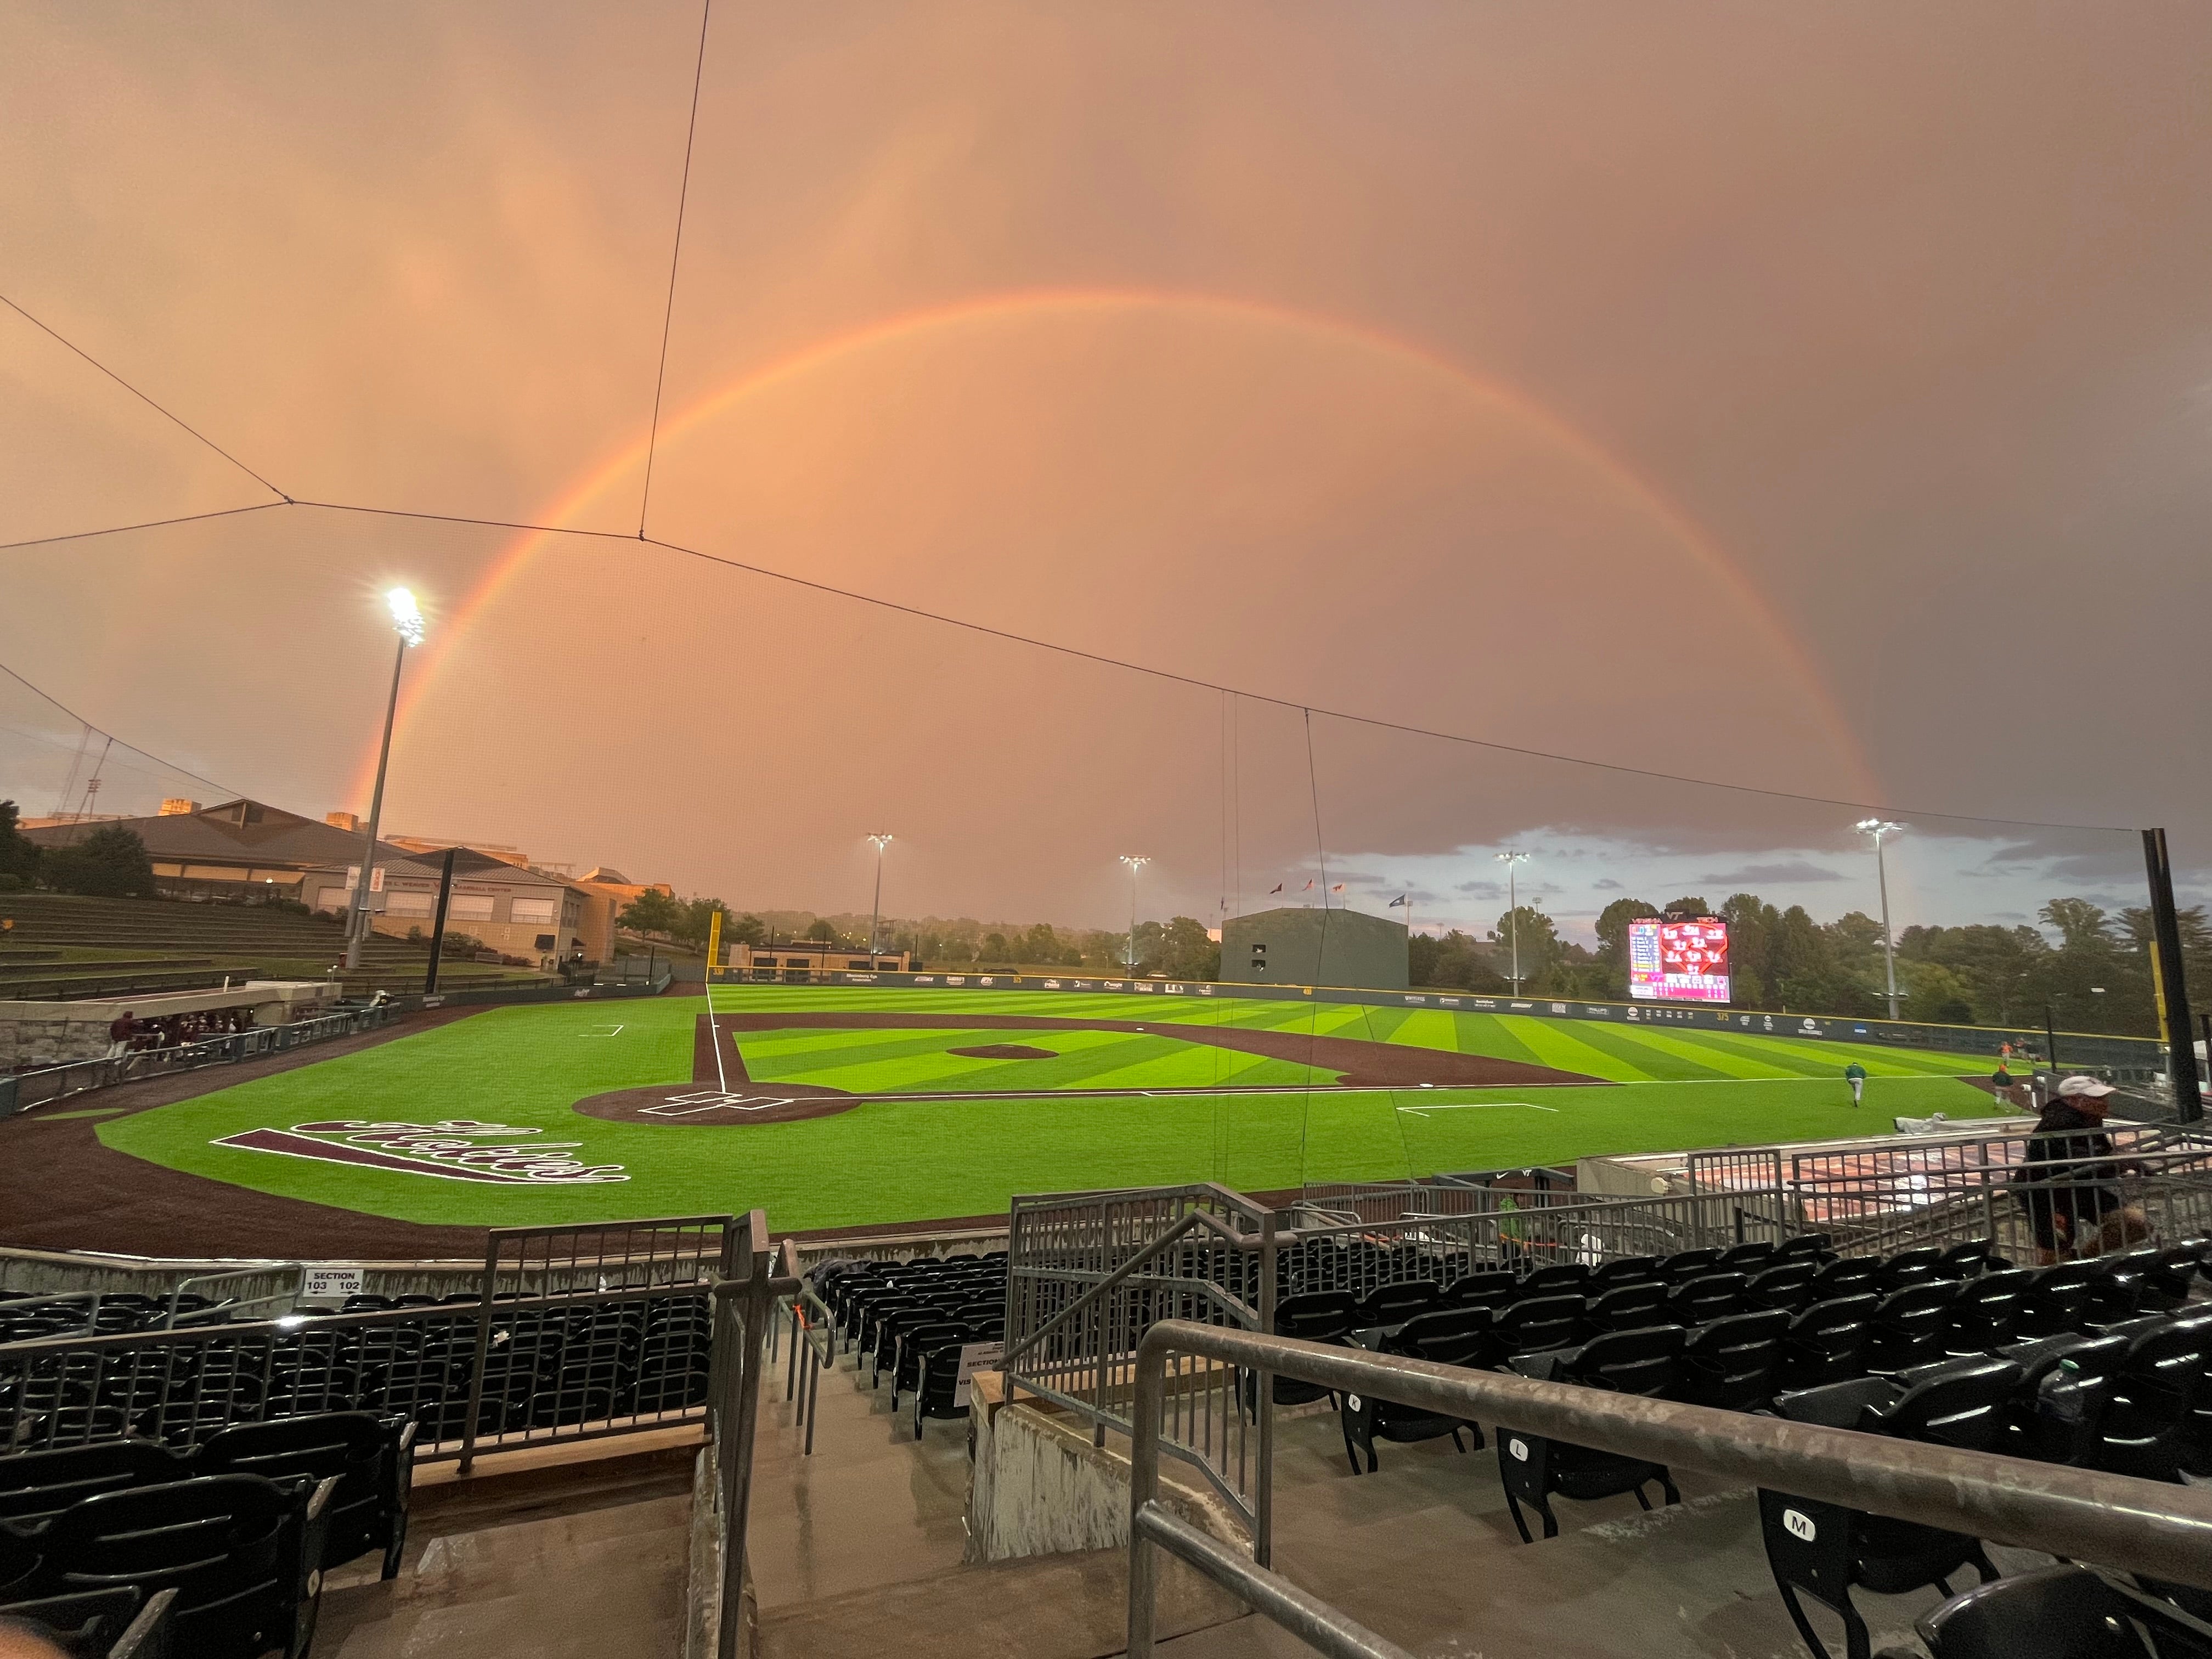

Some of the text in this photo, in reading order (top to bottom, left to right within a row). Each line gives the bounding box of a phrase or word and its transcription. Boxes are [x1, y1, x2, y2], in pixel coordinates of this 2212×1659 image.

[1717, 1012, 1729, 1021] 375
[1516, 1444, 1521, 1457] L
[1792, 1516, 1806, 1535] M
